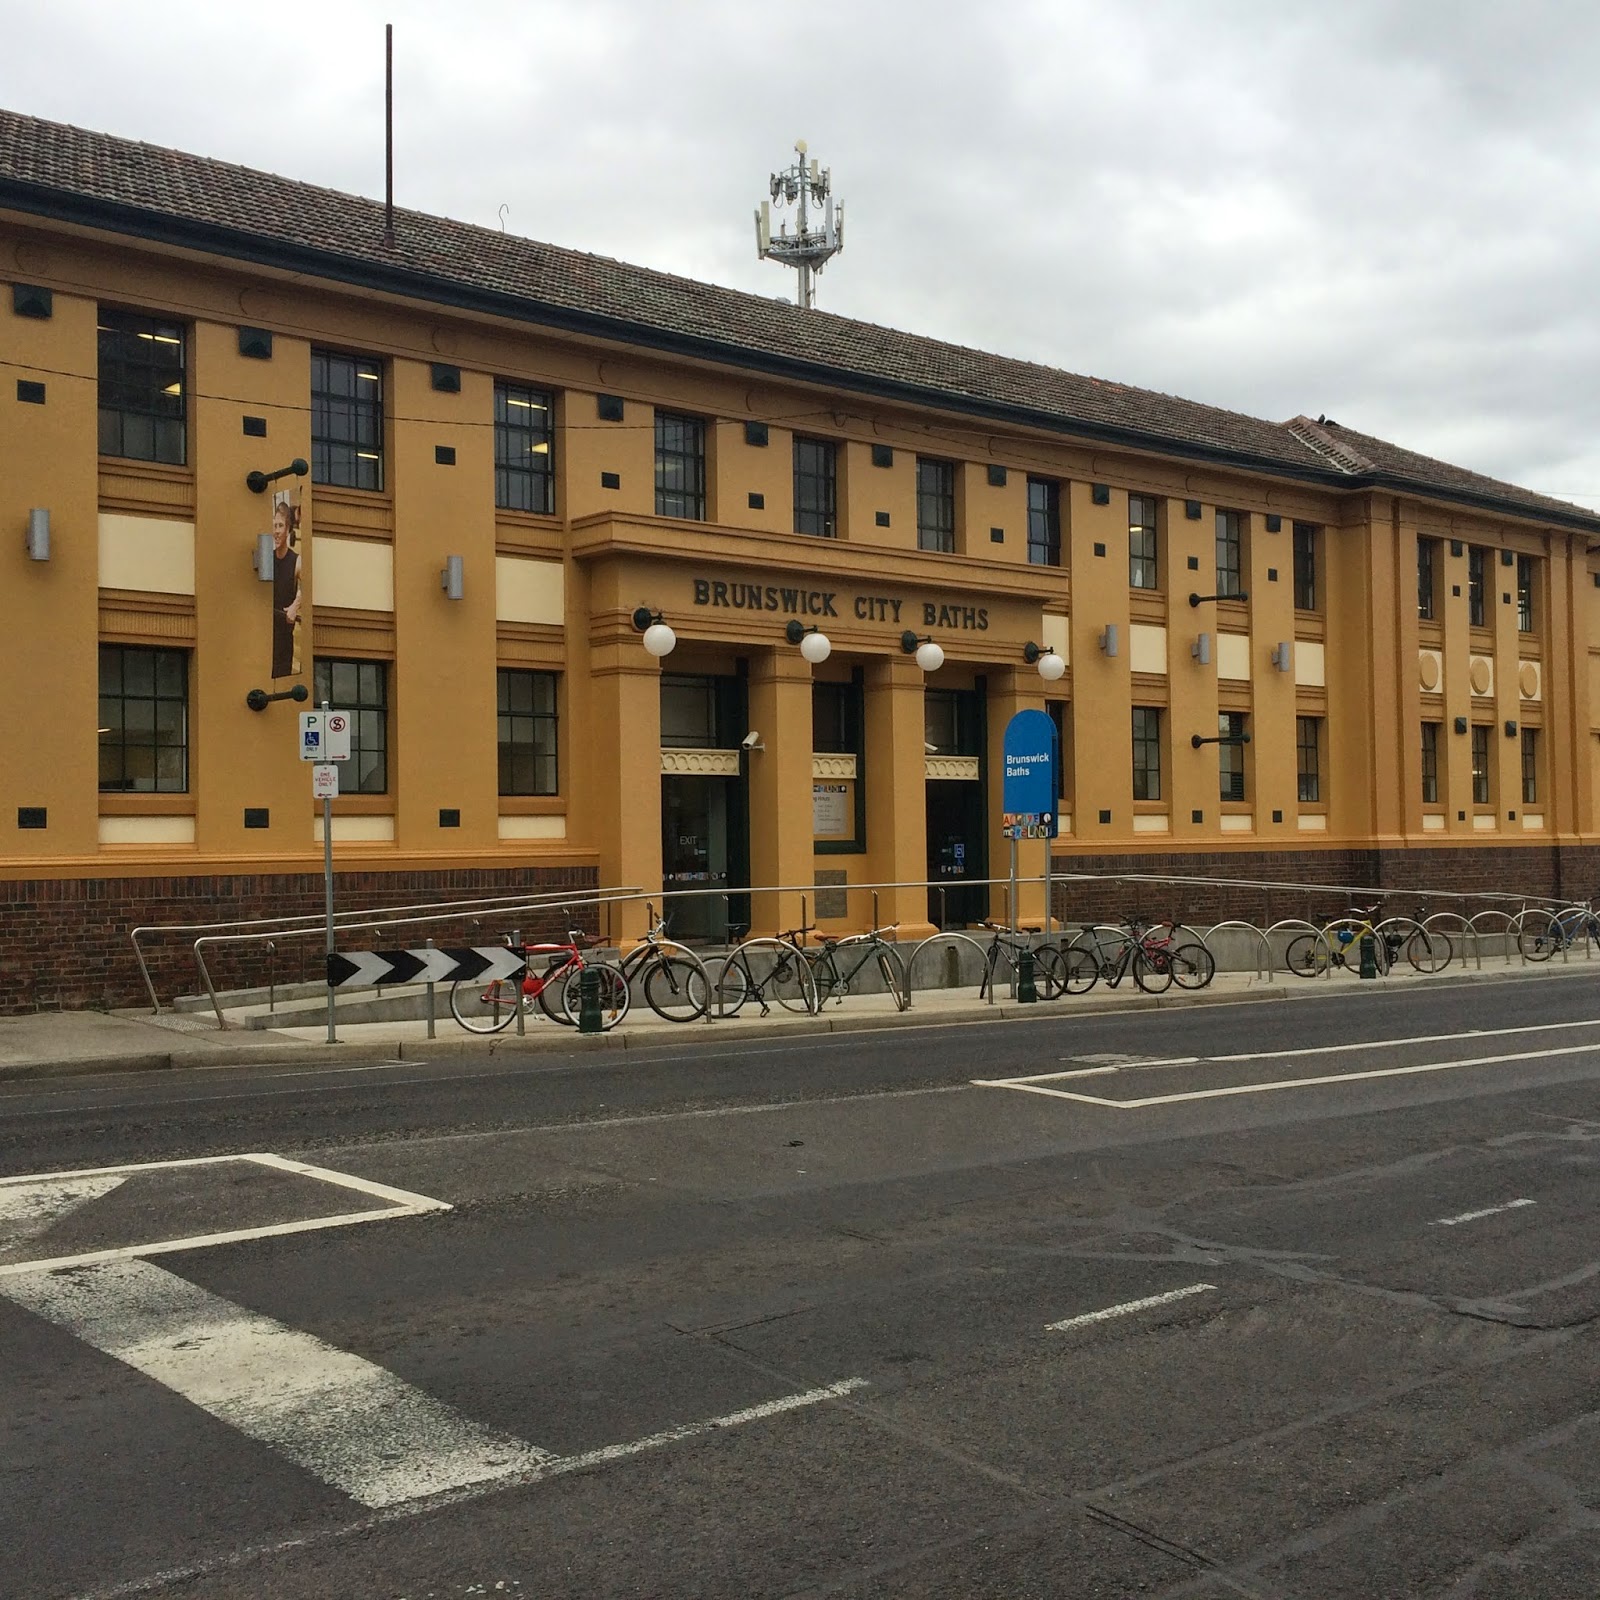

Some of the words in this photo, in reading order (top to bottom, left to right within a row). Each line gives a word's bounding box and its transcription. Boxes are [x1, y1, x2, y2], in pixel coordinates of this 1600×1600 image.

[694, 579, 838, 617] BRUNSWICK
[854, 596, 902, 623] CITY
[923, 602, 989, 631] BATHS
[307, 716, 317, 728] P
[1006, 752, 1050, 765] Brunswick
[1006, 766, 1030, 777] Baths
[680, 835, 697, 845] EXIT
